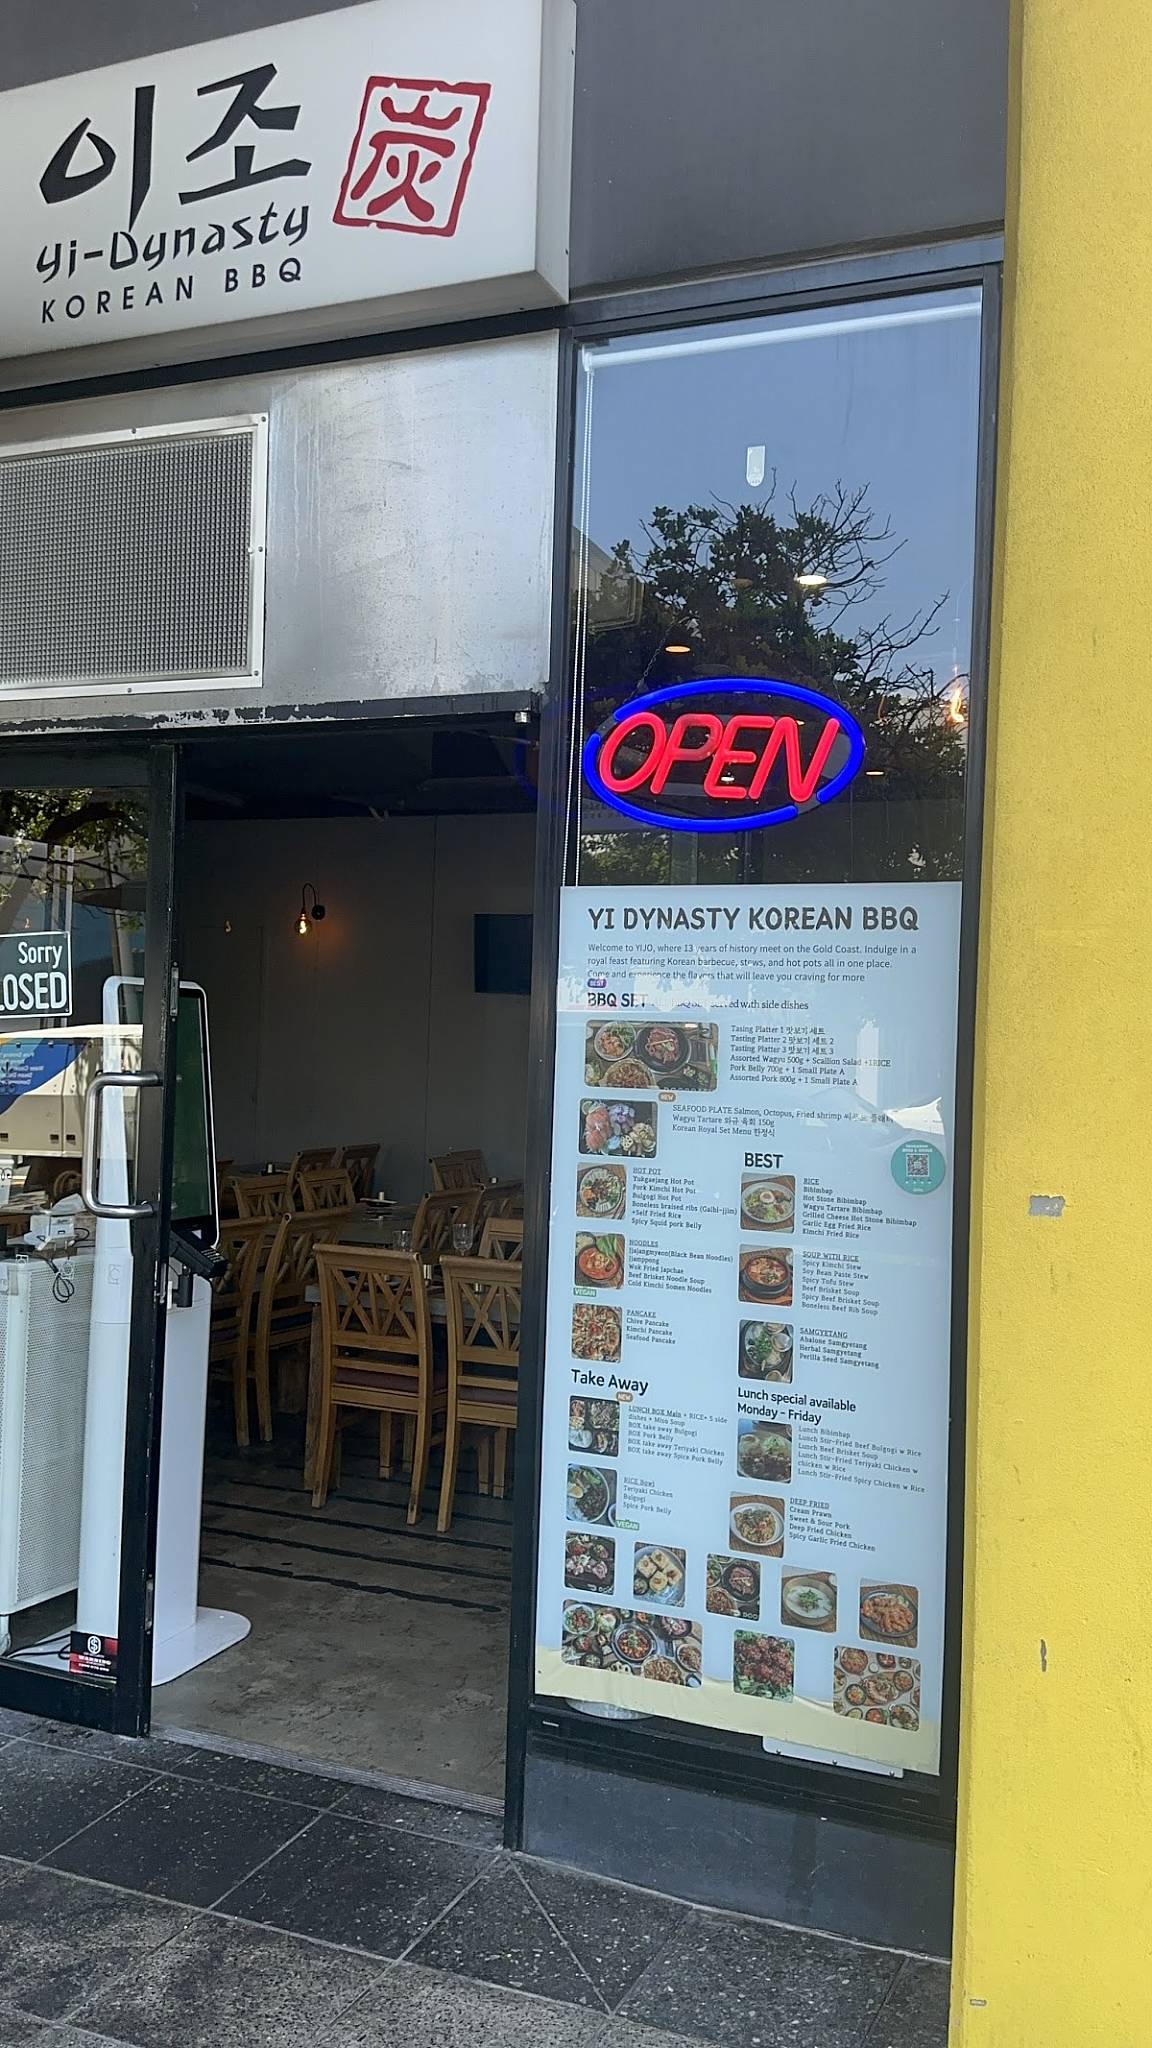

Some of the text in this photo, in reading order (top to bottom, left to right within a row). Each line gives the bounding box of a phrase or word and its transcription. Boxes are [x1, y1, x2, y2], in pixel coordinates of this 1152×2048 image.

[40, 64, 312, 230] 이조
[42, 257, 301, 323] KOREAN BBQ
[600, 712, 840, 802] OPEN
[588, 907, 919, 930] YI DYNASTY KOREAN BBQ
[18, 941, 62, 969] Sorry
[636, 944, 655, 953] YIJO,
[719, 945, 727, 953] of
[730, 945, 758, 954] history
[760, 945, 781, 953] meet
[797, 945, 808, 953] the
[813, 945, 832, 953] Gold
[835, 945, 861, 954] Coast.
[865, 945, 897, 955] Indulge
[900, 946, 908, 954] in
[588, 958, 606, 966] royal
[609, 957, 628, 965] feast
[630, 958, 665, 967] featuring
[668, 958, 695, 966] Korean
[698, 959, 737, 967] barbecue,
[673, 971, 686, 979] the
[717, 972, 733, 980] that
[736, 972, 750, 980] will
[777, 974, 791, 982] you
[795, 974, 825, 983] craving
[828, 973, 838, 981] for
[588, 992, 617, 1007] BBQ
[762, 1001, 808, 1009] side dishes
[755, 1026, 778, 1034] Platter
[731, 1035, 755, 1044] Tasting
[731, 1045, 755, 1054] Tasting
[788, 1057, 803, 1065] 500g
[842, 1058, 861, 1066] Salad
[748, 1065, 765, 1073] Belly
[767, 1066, 783, 1074] 700g
[730, 1074, 759, 1082] Assorted
[811, 1077, 830, 1085] Small
[833, 1078, 849, 1086] Plate
[672, 1105, 708, 1113] SEAFOOD
[710, 1106, 732, 1114] PLATE
[763, 1109, 794, 1118] Octopus,
[672, 1115, 774, 1127] Wagyu Tartare 150g
[672, 1124, 695, 1132] Korean
[698, 1125, 716, 1134] Royal
[720, 1126, 730, 1134] Set
[733, 1127, 751, 1135] Menu
[744, 1152, 783, 1168] BEST
[572, 1369, 648, 1395] Take Away
[738, 1387, 856, 1411] Lunch special available
[737, 1403, 778, 1420] Monday
[789, 1410, 822, 1425] Friday
[617, 1521, 639, 1529] VEGAN
